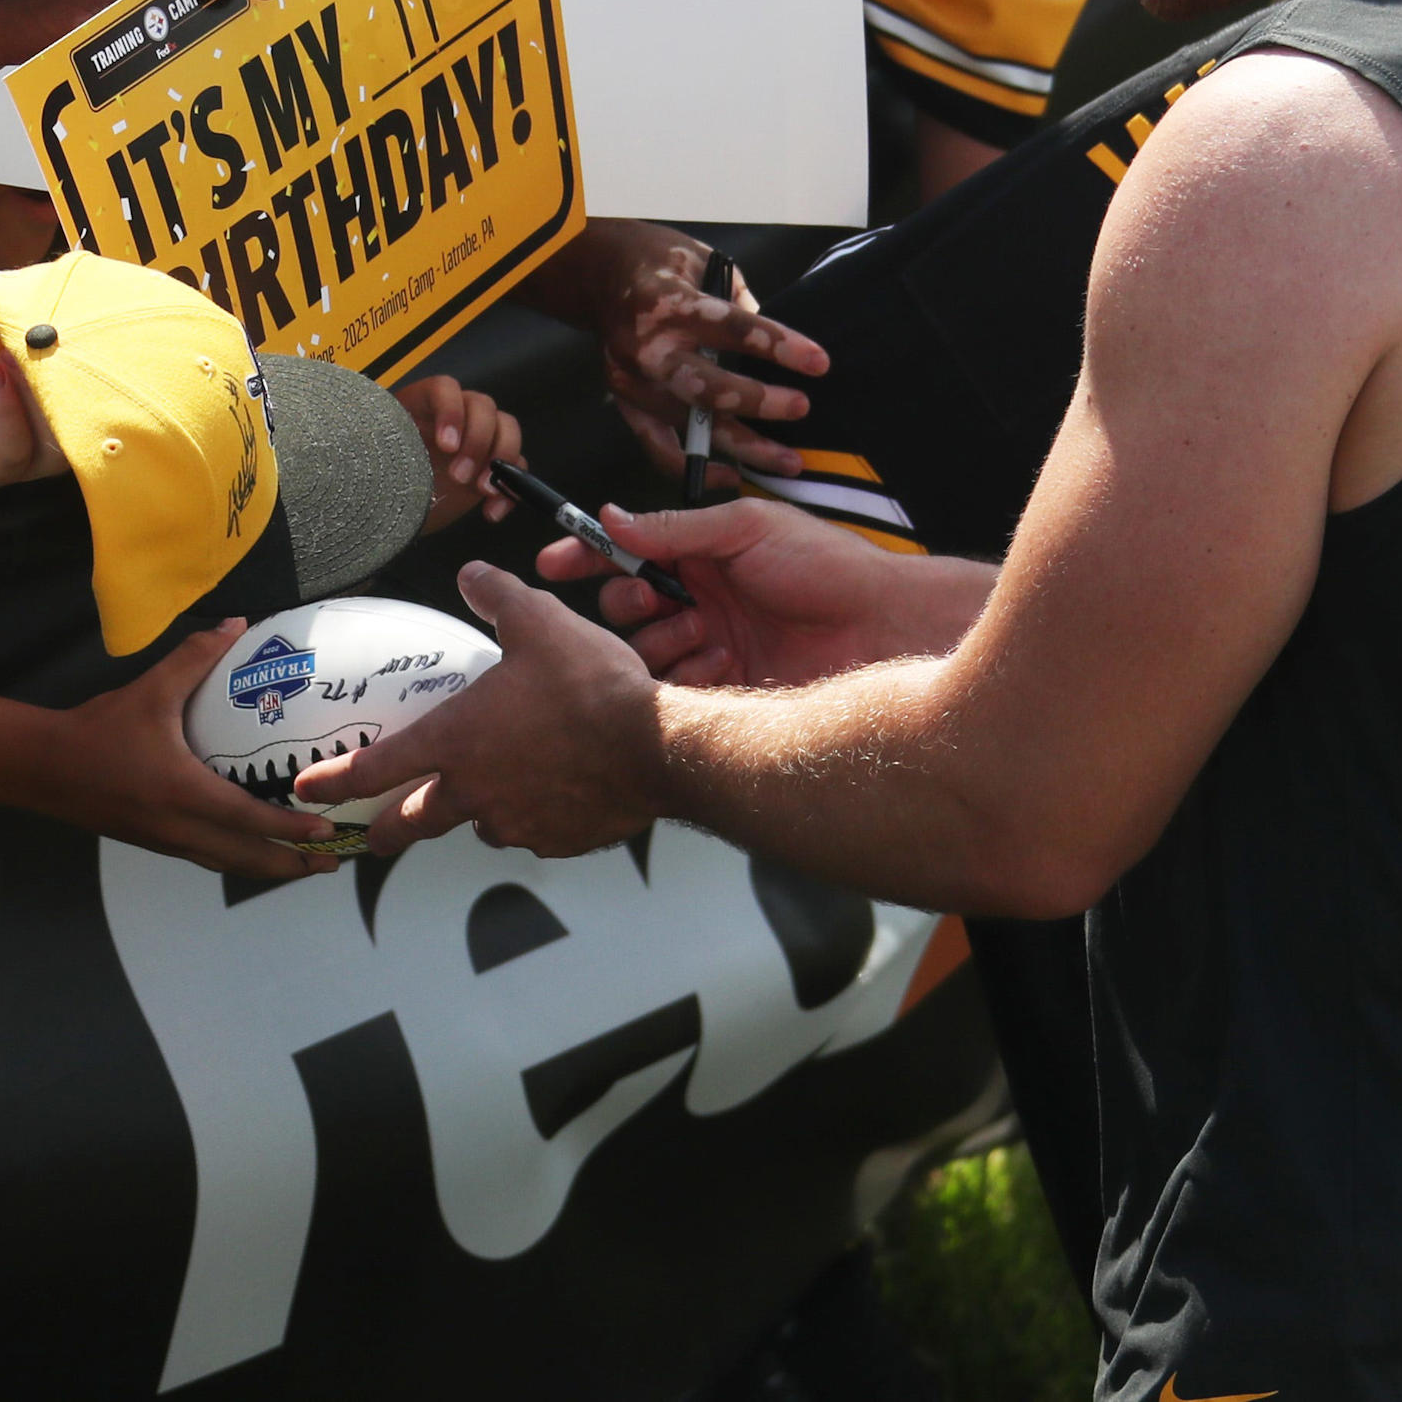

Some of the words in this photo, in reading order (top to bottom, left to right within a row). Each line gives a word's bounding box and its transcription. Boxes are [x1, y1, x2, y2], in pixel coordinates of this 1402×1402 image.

[90, 26, 145, 73] TRAINING
[107, 84, 249, 268] IT'S
[239, 1, 351, 175] MY
[167, 18, 533, 348] IRTHDAY!
[342, 313, 370, 354] 2025
[369, 290, 409, 331] Training
[408, 266, 436, 302] Camp
[441, 232, 482, 275] Latrobe,
[481, 214, 495, 244] PA
[232, 658, 312, 693] TRAINING
[259, 692, 281, 712] NFL
